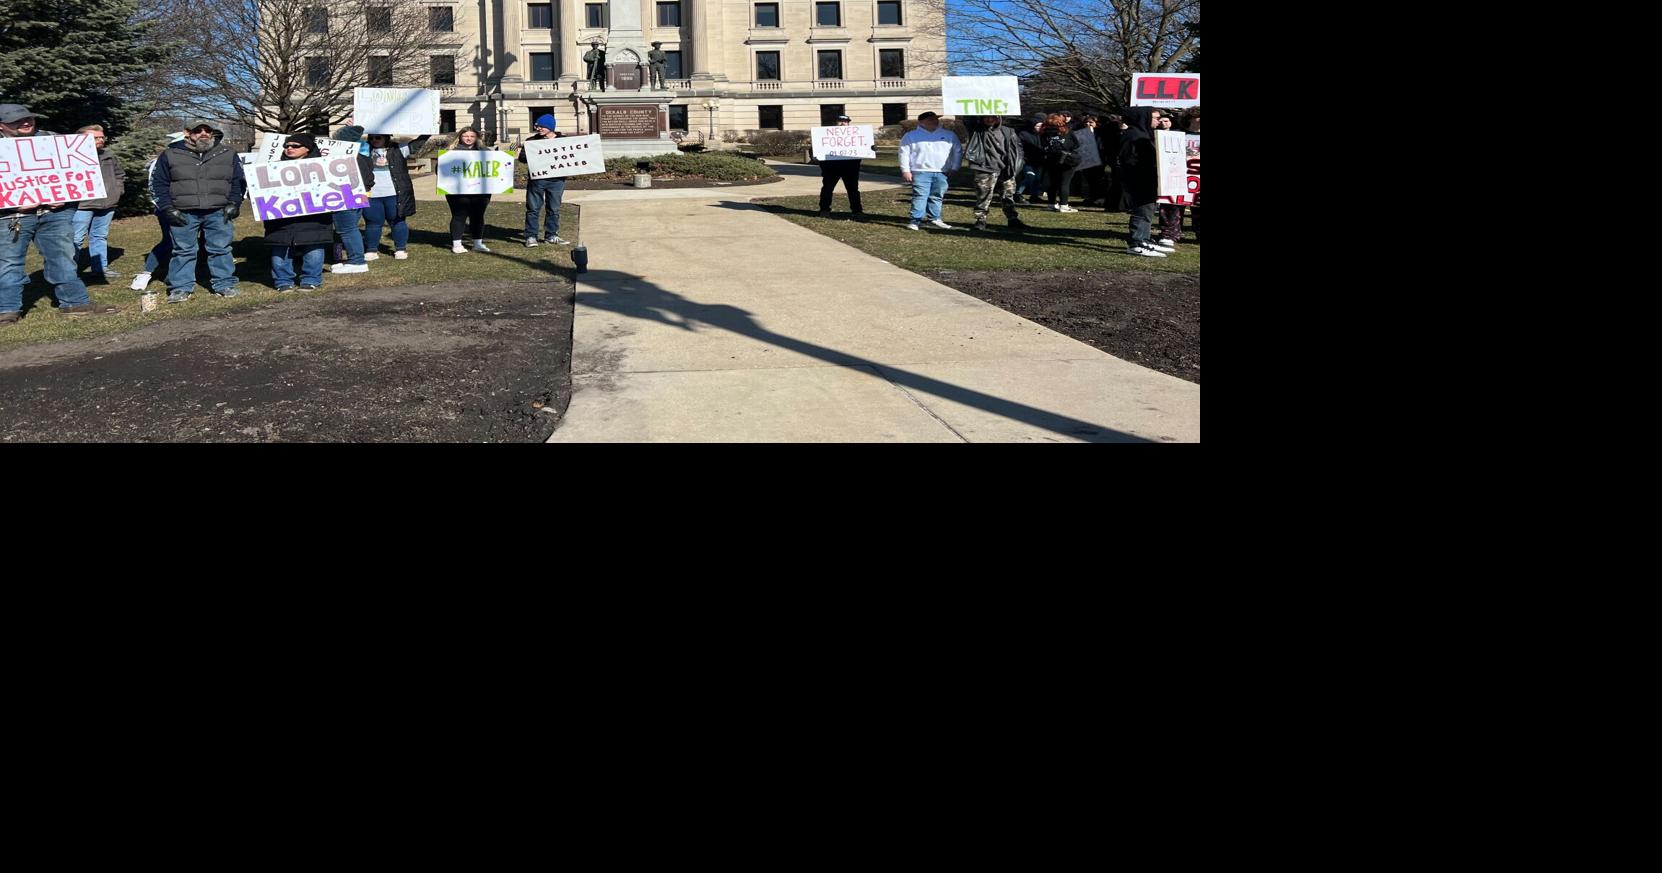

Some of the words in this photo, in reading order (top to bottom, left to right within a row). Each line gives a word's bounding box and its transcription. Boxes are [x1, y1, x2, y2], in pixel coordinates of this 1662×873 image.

[1137, 80, 1195, 99] LLK
[826, 126, 859, 136] NEVER
[821, 135, 867, 148] FORGET.
[538, 143, 589, 155] JUSTICE
[554, 153, 575, 161] FOR
[451, 160, 500, 178] #KALEB
[550, 160, 588, 170] KALEB
[255, 157, 360, 191] Long
[531, 170, 548, 178] LLK
[0, 180, 95, 208] KALEB!
